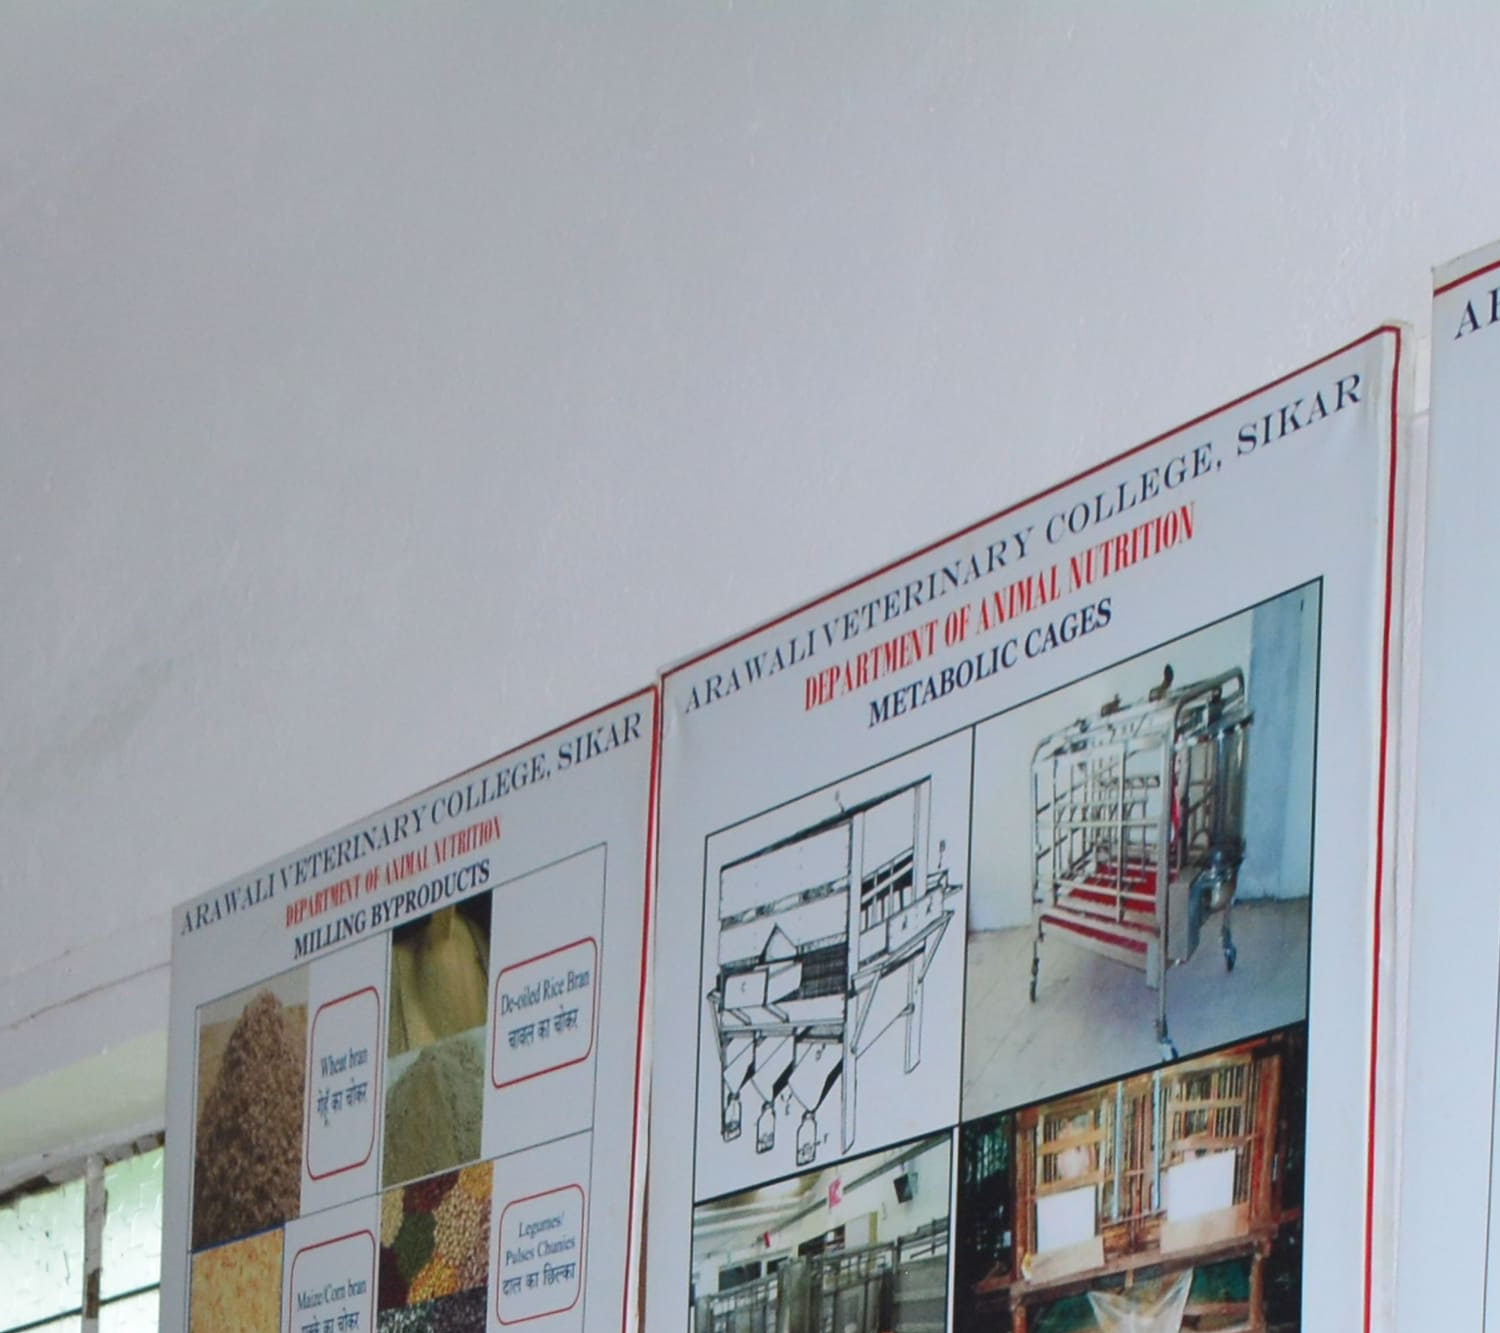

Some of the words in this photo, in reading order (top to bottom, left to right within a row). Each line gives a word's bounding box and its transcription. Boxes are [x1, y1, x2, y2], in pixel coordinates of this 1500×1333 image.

[684, 629, 817, 713] ARAWALI
[823, 527, 1035, 647] VETERINARY
[1045, 442, 1222, 544] COLLEGE,
[1236, 373, 1361, 456] SIKAR
[804, 619, 939, 712] DEPARTMENT
[944, 603, 971, 647] OF
[976, 564, 1061, 636] ANIMAL
[1068, 500, 1195, 594] NUTRITION
[868, 638, 1017, 727] METABOLIC
[1024, 597, 1113, 660] CAGES
[180, 873, 275, 935] ARAWALI
[280, 806, 428, 889] VETERINARY
[557, 712, 642, 771] SIKAR
[285, 874, 361, 928] DEPARTMENT
[364, 865, 380, 895] OF
[384, 845, 429, 885] ANIMAL
[433, 814, 502, 866] NUTRITION
[293, 910, 366, 960] MILLING
[370, 859, 490, 928] BYPRODUCTS
[543, 976, 565, 1001] Rice
[567, 970, 590, 992] Bran
